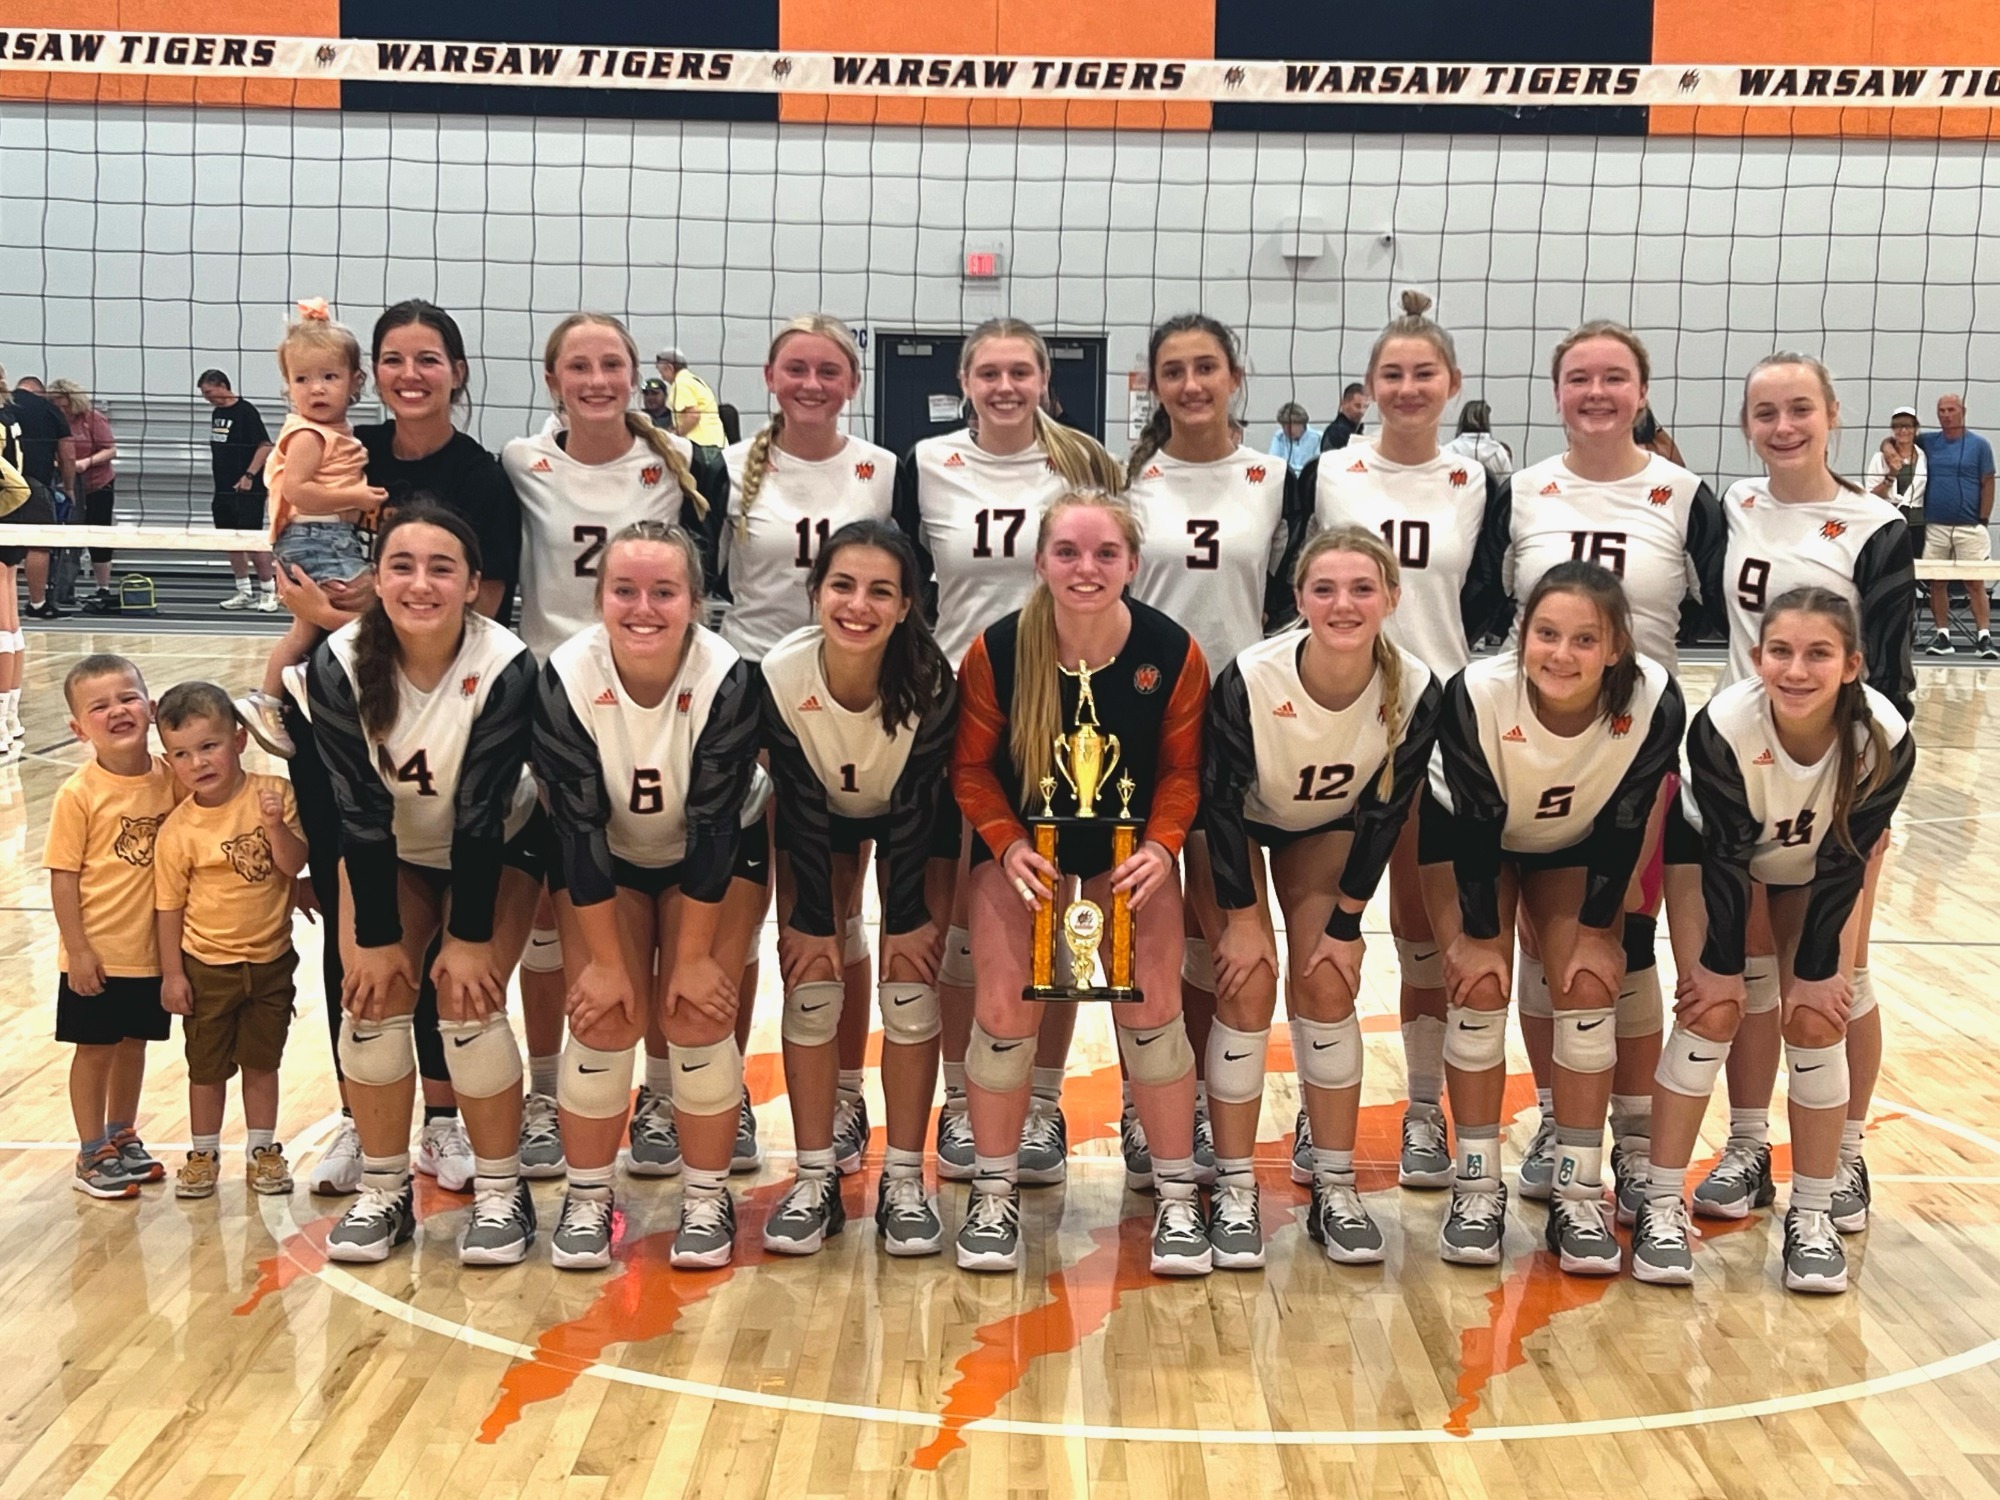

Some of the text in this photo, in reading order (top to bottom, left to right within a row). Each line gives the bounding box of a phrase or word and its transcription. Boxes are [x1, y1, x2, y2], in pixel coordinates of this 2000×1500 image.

[120, 36, 276, 66] TIGERS
[377, 43, 734, 80] WARSAW TIGERS
[833, 57, 1186, 89] WARSAW TIGERS
[1285, 66, 1640, 94] WARSAW TIGERS
[1739, 69, 1928, 96] WARSAW
[573, 525, 607, 577] 2
[795, 517, 830, 567] 11
[973, 508, 1026, 558] 17
[1186, 519, 1219, 570] 3
[1380, 519, 1430, 569] 10
[1738, 557, 1771, 613] 9
[398, 749, 438, 796] 4
[629, 766, 664, 814] 6
[840, 763, 860, 793] 1
[1293, 764, 1355, 801] 12
[1534, 785, 1576, 819] 5
